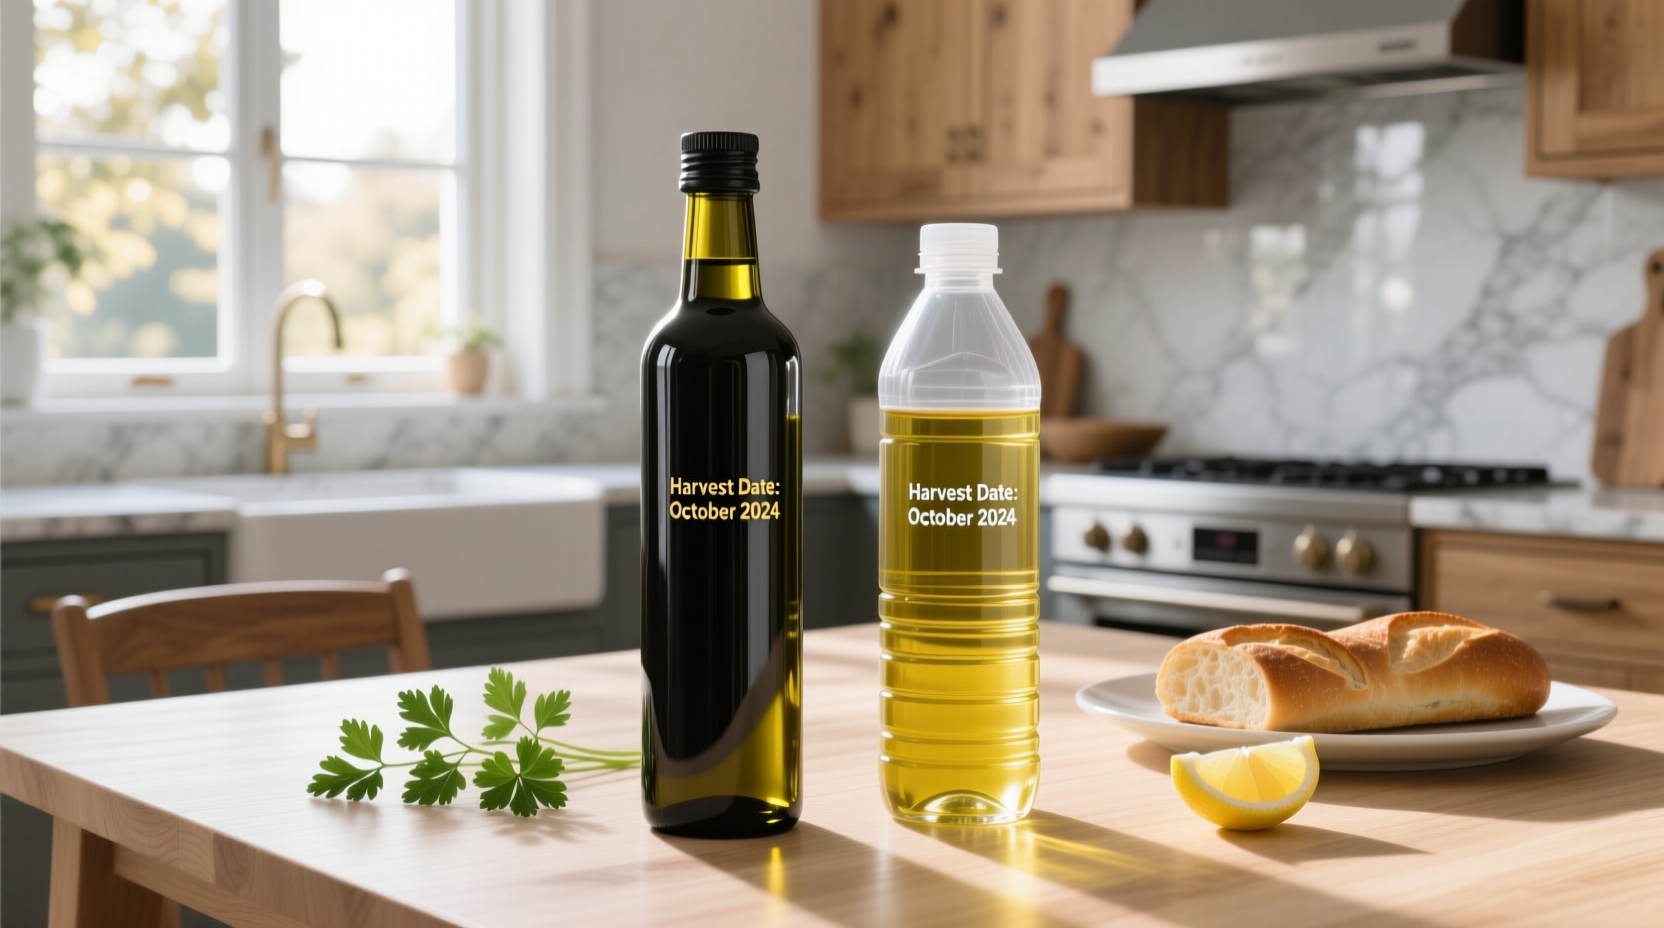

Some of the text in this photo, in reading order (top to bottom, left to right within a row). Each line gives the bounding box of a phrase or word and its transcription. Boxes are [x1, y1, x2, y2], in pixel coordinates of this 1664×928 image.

[669, 476, 781, 496] Harvest Date:
[908, 483, 1019, 502] Harvest Date:
[669, 501, 781, 521] October 2024
[907, 508, 1018, 527] October 2024
